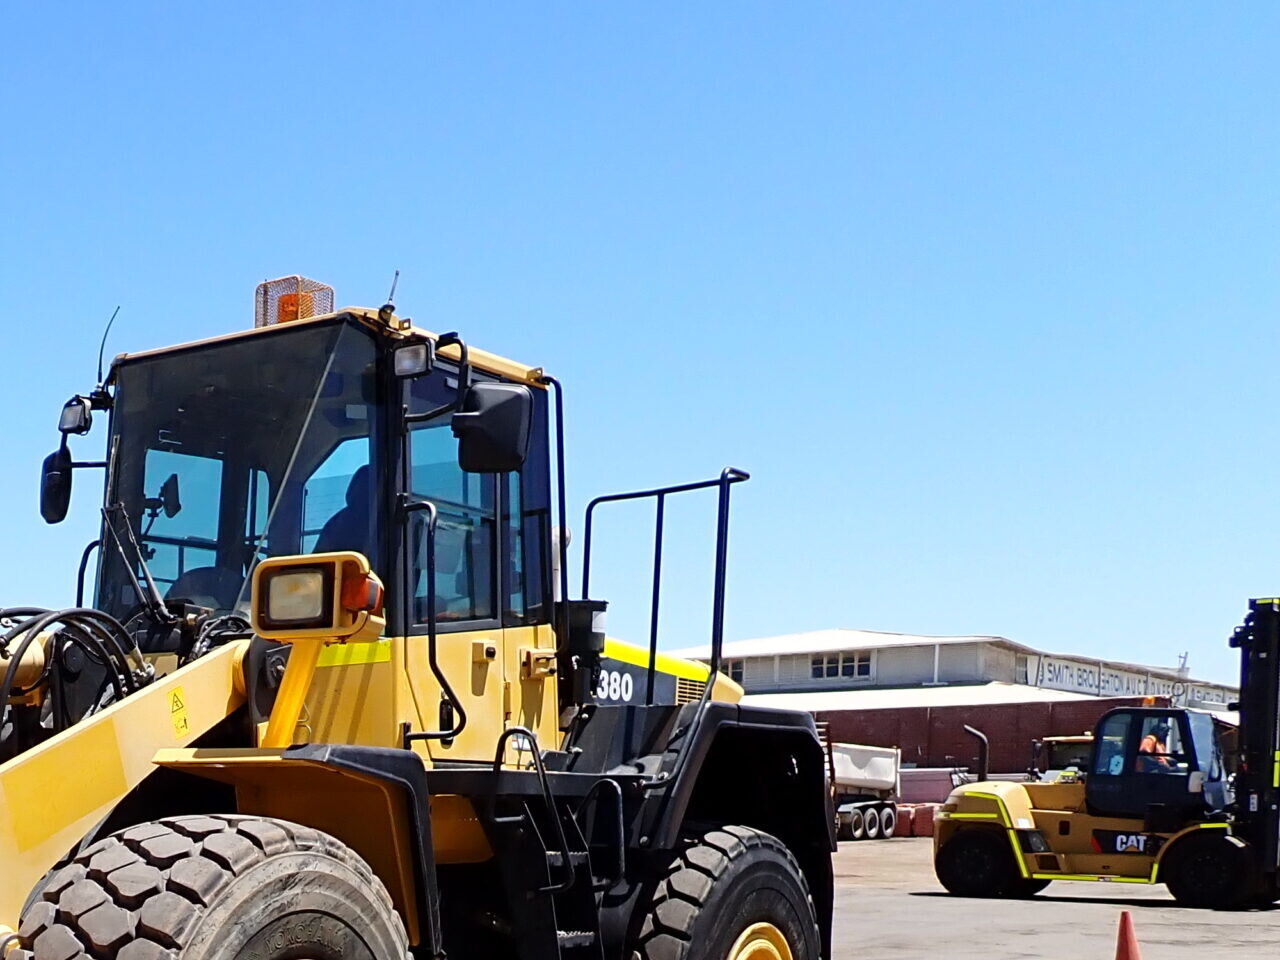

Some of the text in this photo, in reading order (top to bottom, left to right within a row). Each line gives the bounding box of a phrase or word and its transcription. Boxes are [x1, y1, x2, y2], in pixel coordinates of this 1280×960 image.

[597, 669, 633, 702] 380
[1047, 662, 1074, 685] SMITH
[1116, 834, 1147, 852] CAT
[266, 920, 349, 956] YOKOHAMA
